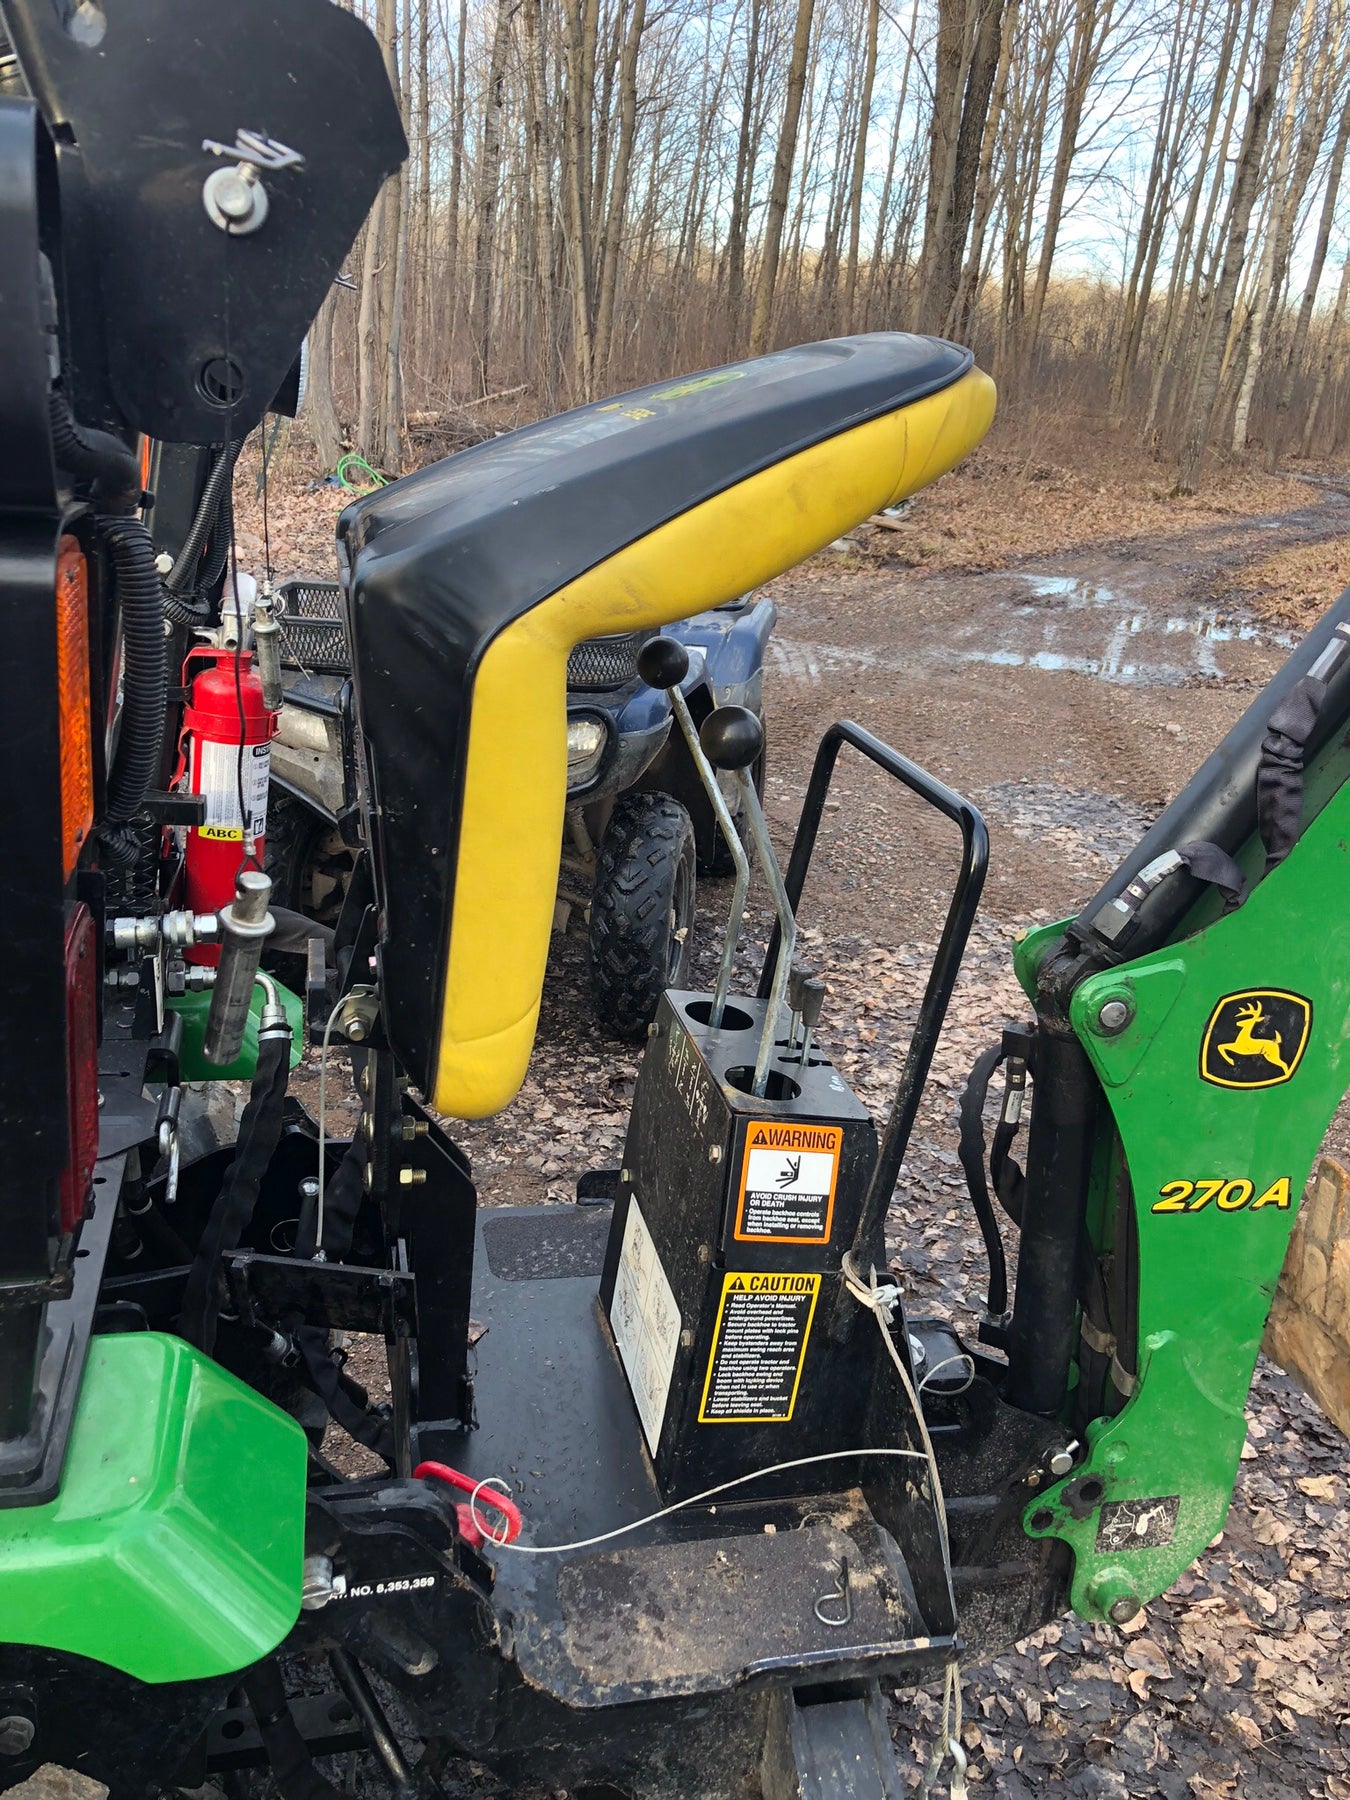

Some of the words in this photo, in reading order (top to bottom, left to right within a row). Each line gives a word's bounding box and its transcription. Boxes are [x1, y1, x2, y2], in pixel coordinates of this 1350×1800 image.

[207, 828, 237, 838] ABC
[769, 1129, 836, 1149] WARNING
[750, 1276, 815, 1291] CAUTION
[351, 1586, 374, 1597] NO.
